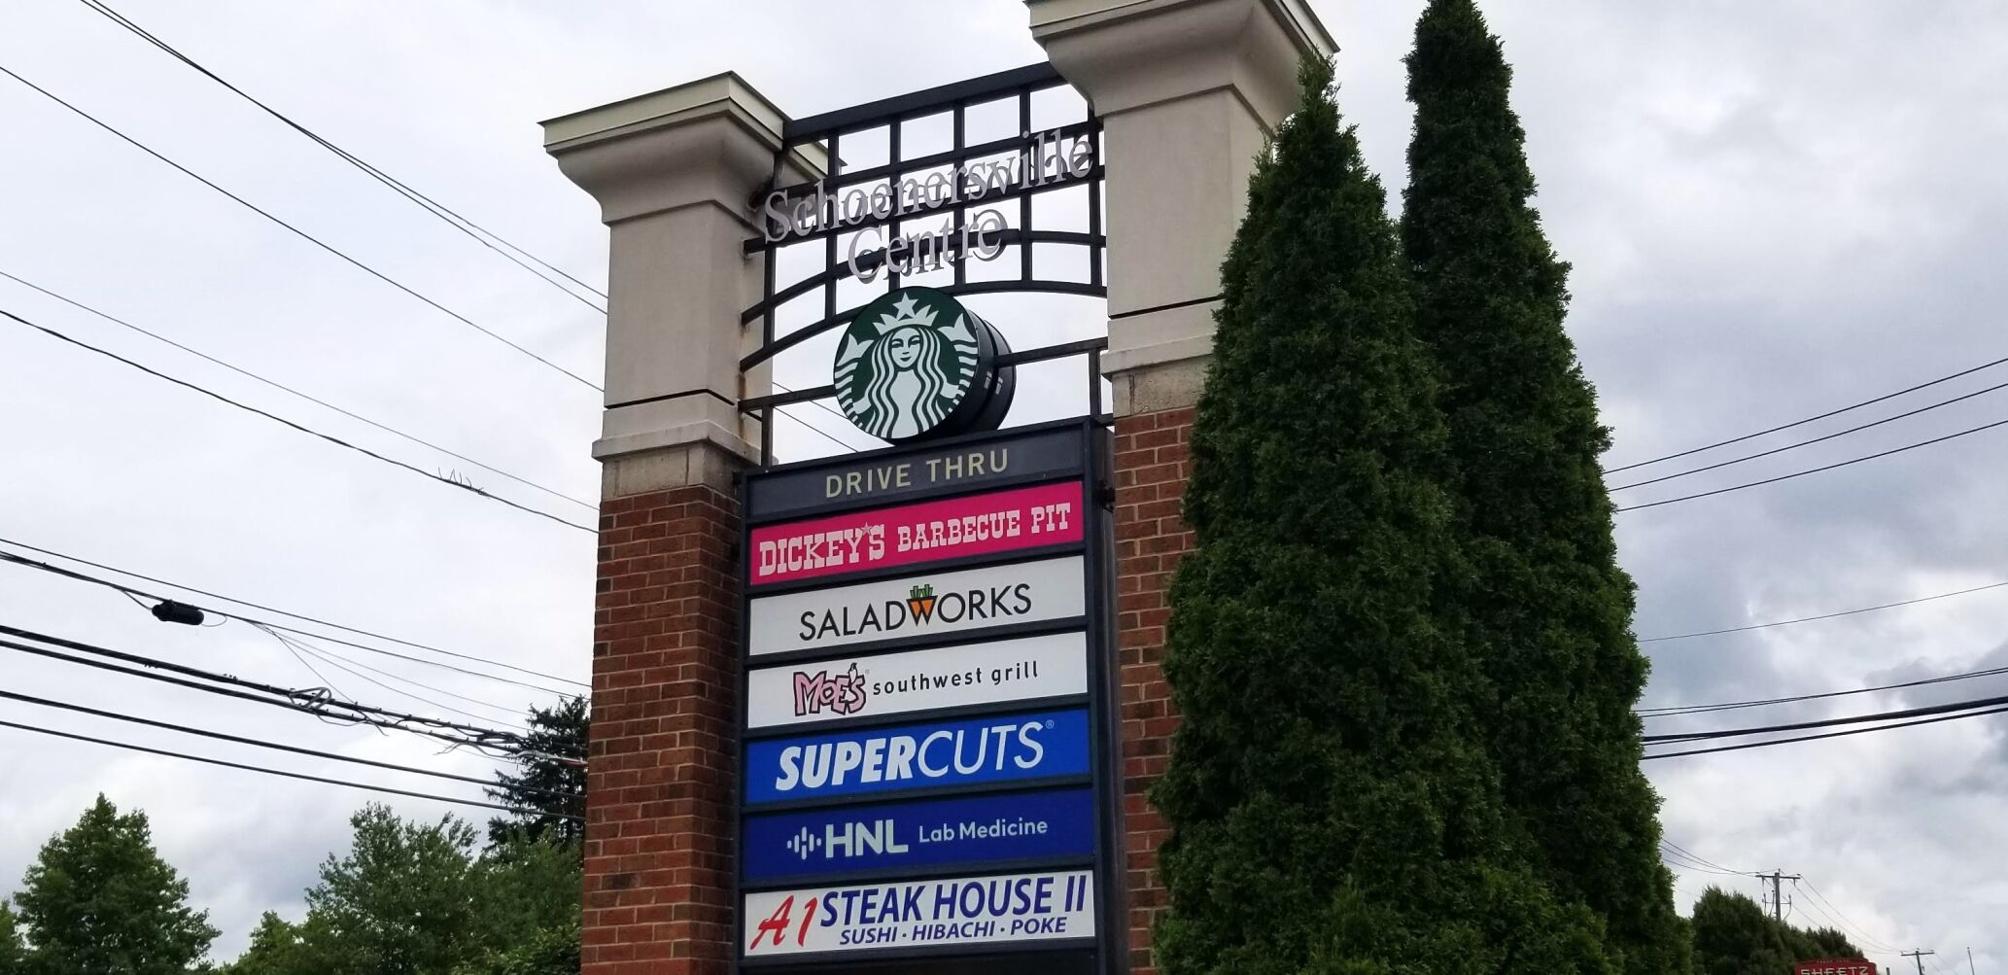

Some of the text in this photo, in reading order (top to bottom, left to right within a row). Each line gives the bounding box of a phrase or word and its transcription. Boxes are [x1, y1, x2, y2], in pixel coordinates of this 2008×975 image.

[764, 129, 1093, 243] Schoenersville
[848, 209, 1008, 283] Centre
[825, 449, 1008, 498] DRIVE THRU
[759, 502, 1071, 576] DICKEY'S BARBECUE PIT
[799, 583, 1032, 641] SALADWORKS
[873, 667, 982, 695] southwest
[991, 661, 1038, 684] grill
[825, 817, 1048, 858] HNL Lab Medicine
[750, 875, 1087, 950] A1 STEAK HOUSE II
[839, 917, 1068, 945] SUSHI HIBACHI POKE
